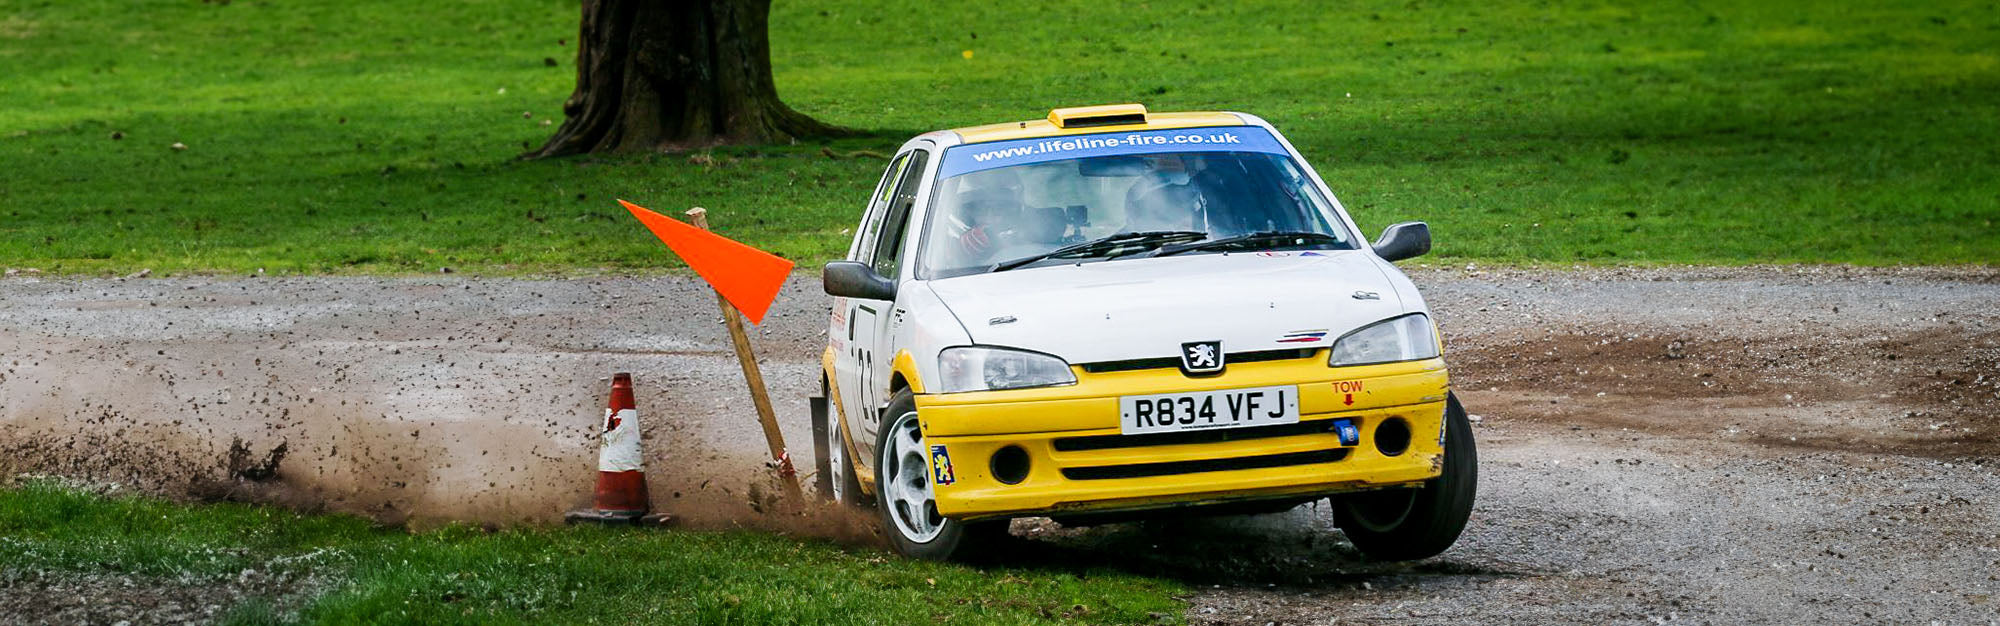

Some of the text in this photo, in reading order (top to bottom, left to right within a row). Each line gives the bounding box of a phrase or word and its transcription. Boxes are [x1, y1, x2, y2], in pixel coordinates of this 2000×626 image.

[973, 133, 1240, 162] www.lifeline-fire.co.uk
[1332, 381, 1362, 393] TOW
[1135, 390, 1284, 428] R834 VFJ
